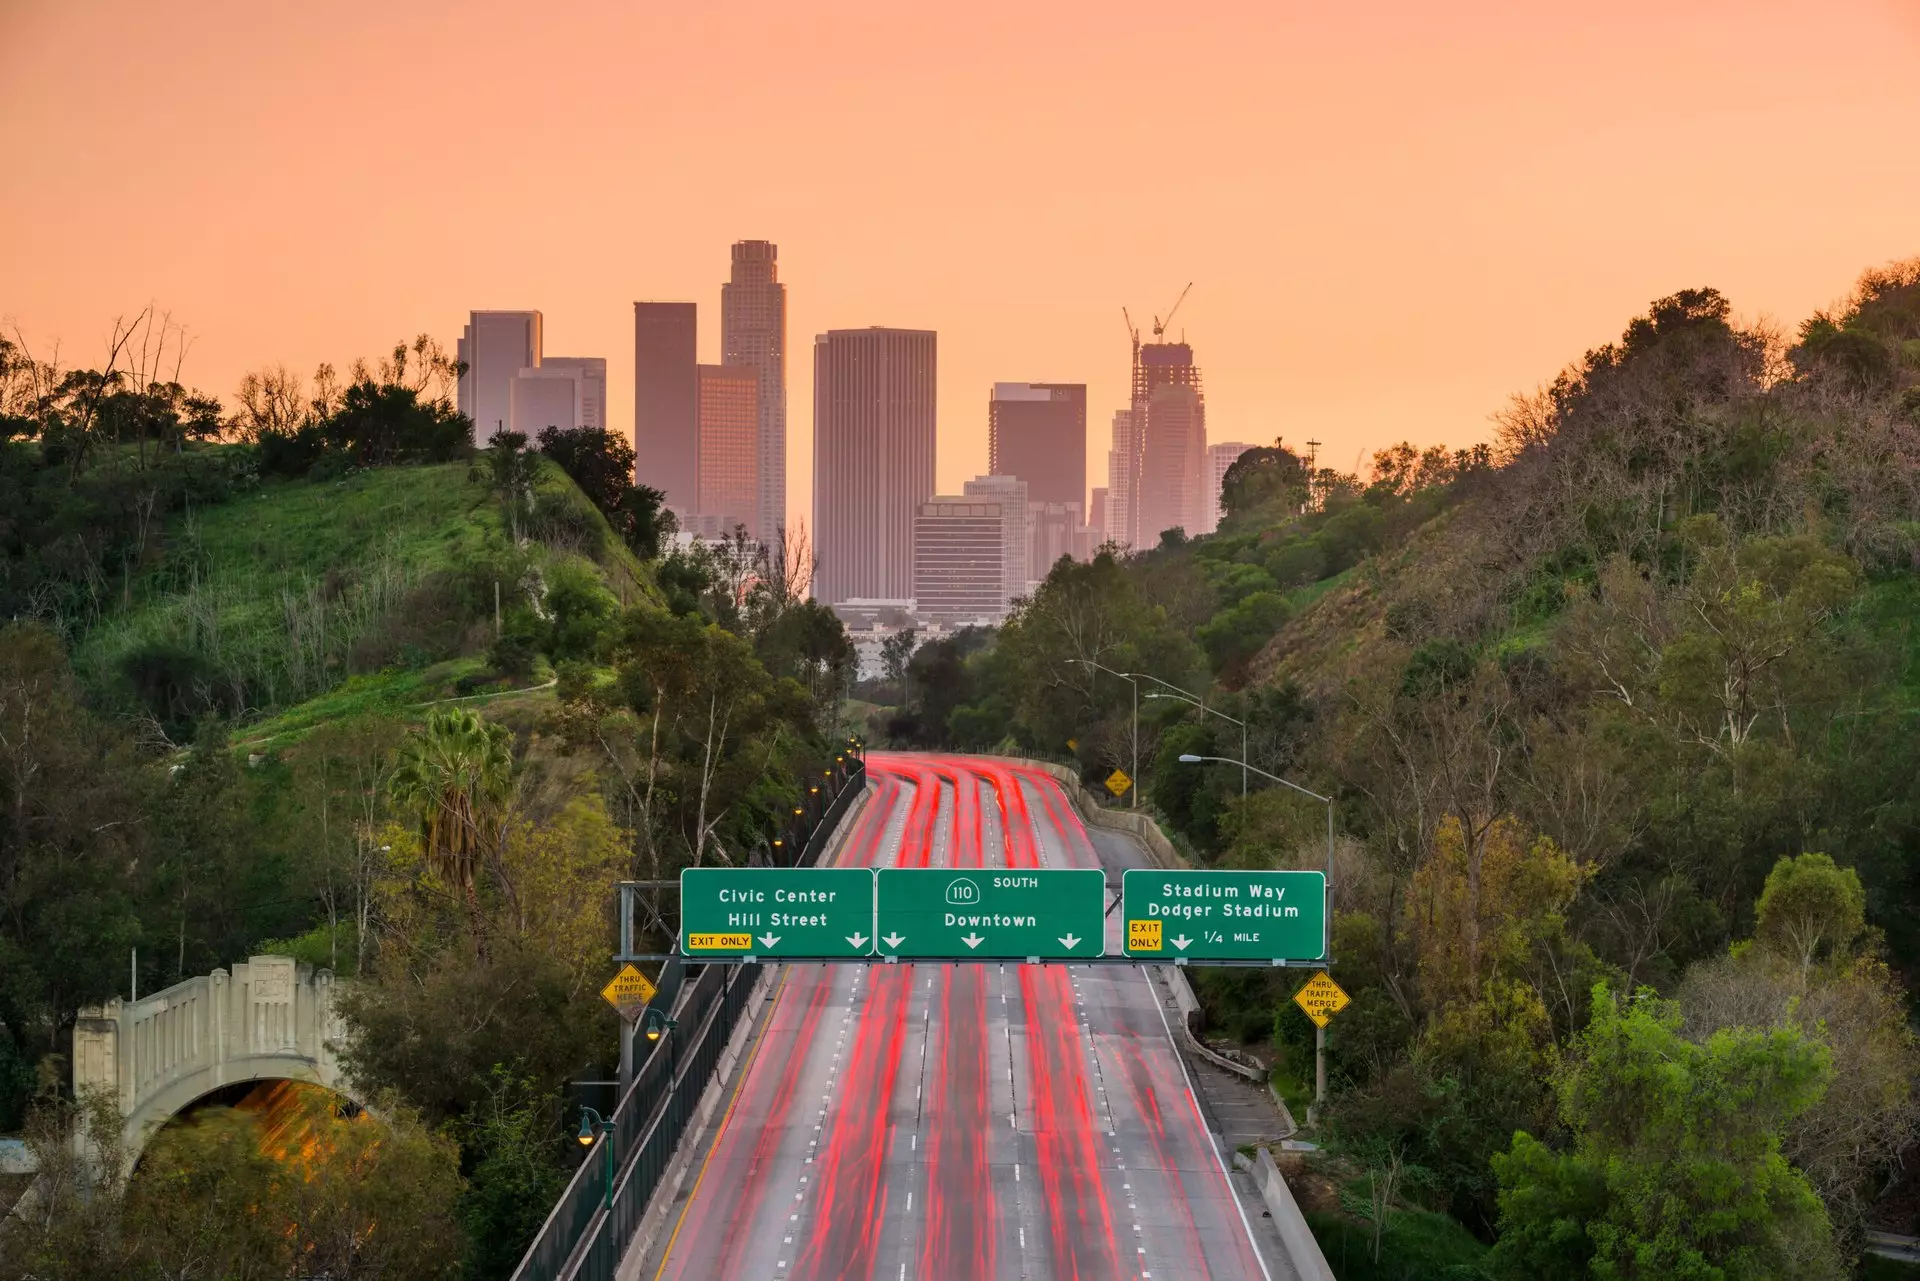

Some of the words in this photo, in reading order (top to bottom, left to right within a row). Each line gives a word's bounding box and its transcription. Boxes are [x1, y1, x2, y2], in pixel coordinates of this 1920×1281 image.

[994, 877, 1038, 888] SOUTH
[719, 889, 764, 903] Civic
[775, 889, 836, 903] Center
[953, 887, 973, 900] 110
[1163, 884, 1239, 897] Stadium
[1249, 884, 1286, 901] Way
[1149, 903, 1212, 920] Dodger
[1223, 903, 1299, 918] Stadium
[728, 912, 760, 926] Hill
[770, 912, 827, 927] Street
[945, 913, 1036, 927] Downtown
[1131, 924, 1160, 932] EXIT
[690, 936, 718, 946] EXIT
[720, 936, 750, 946] ONLY
[1233, 932, 1260, 942] MILE
[1130, 939, 1160, 947] ONLY
[614, 984, 647, 993] TRAFFIC
[1305, 990, 1339, 998] TRAFFIC
[1306, 1000, 1337, 1008] MERGE
